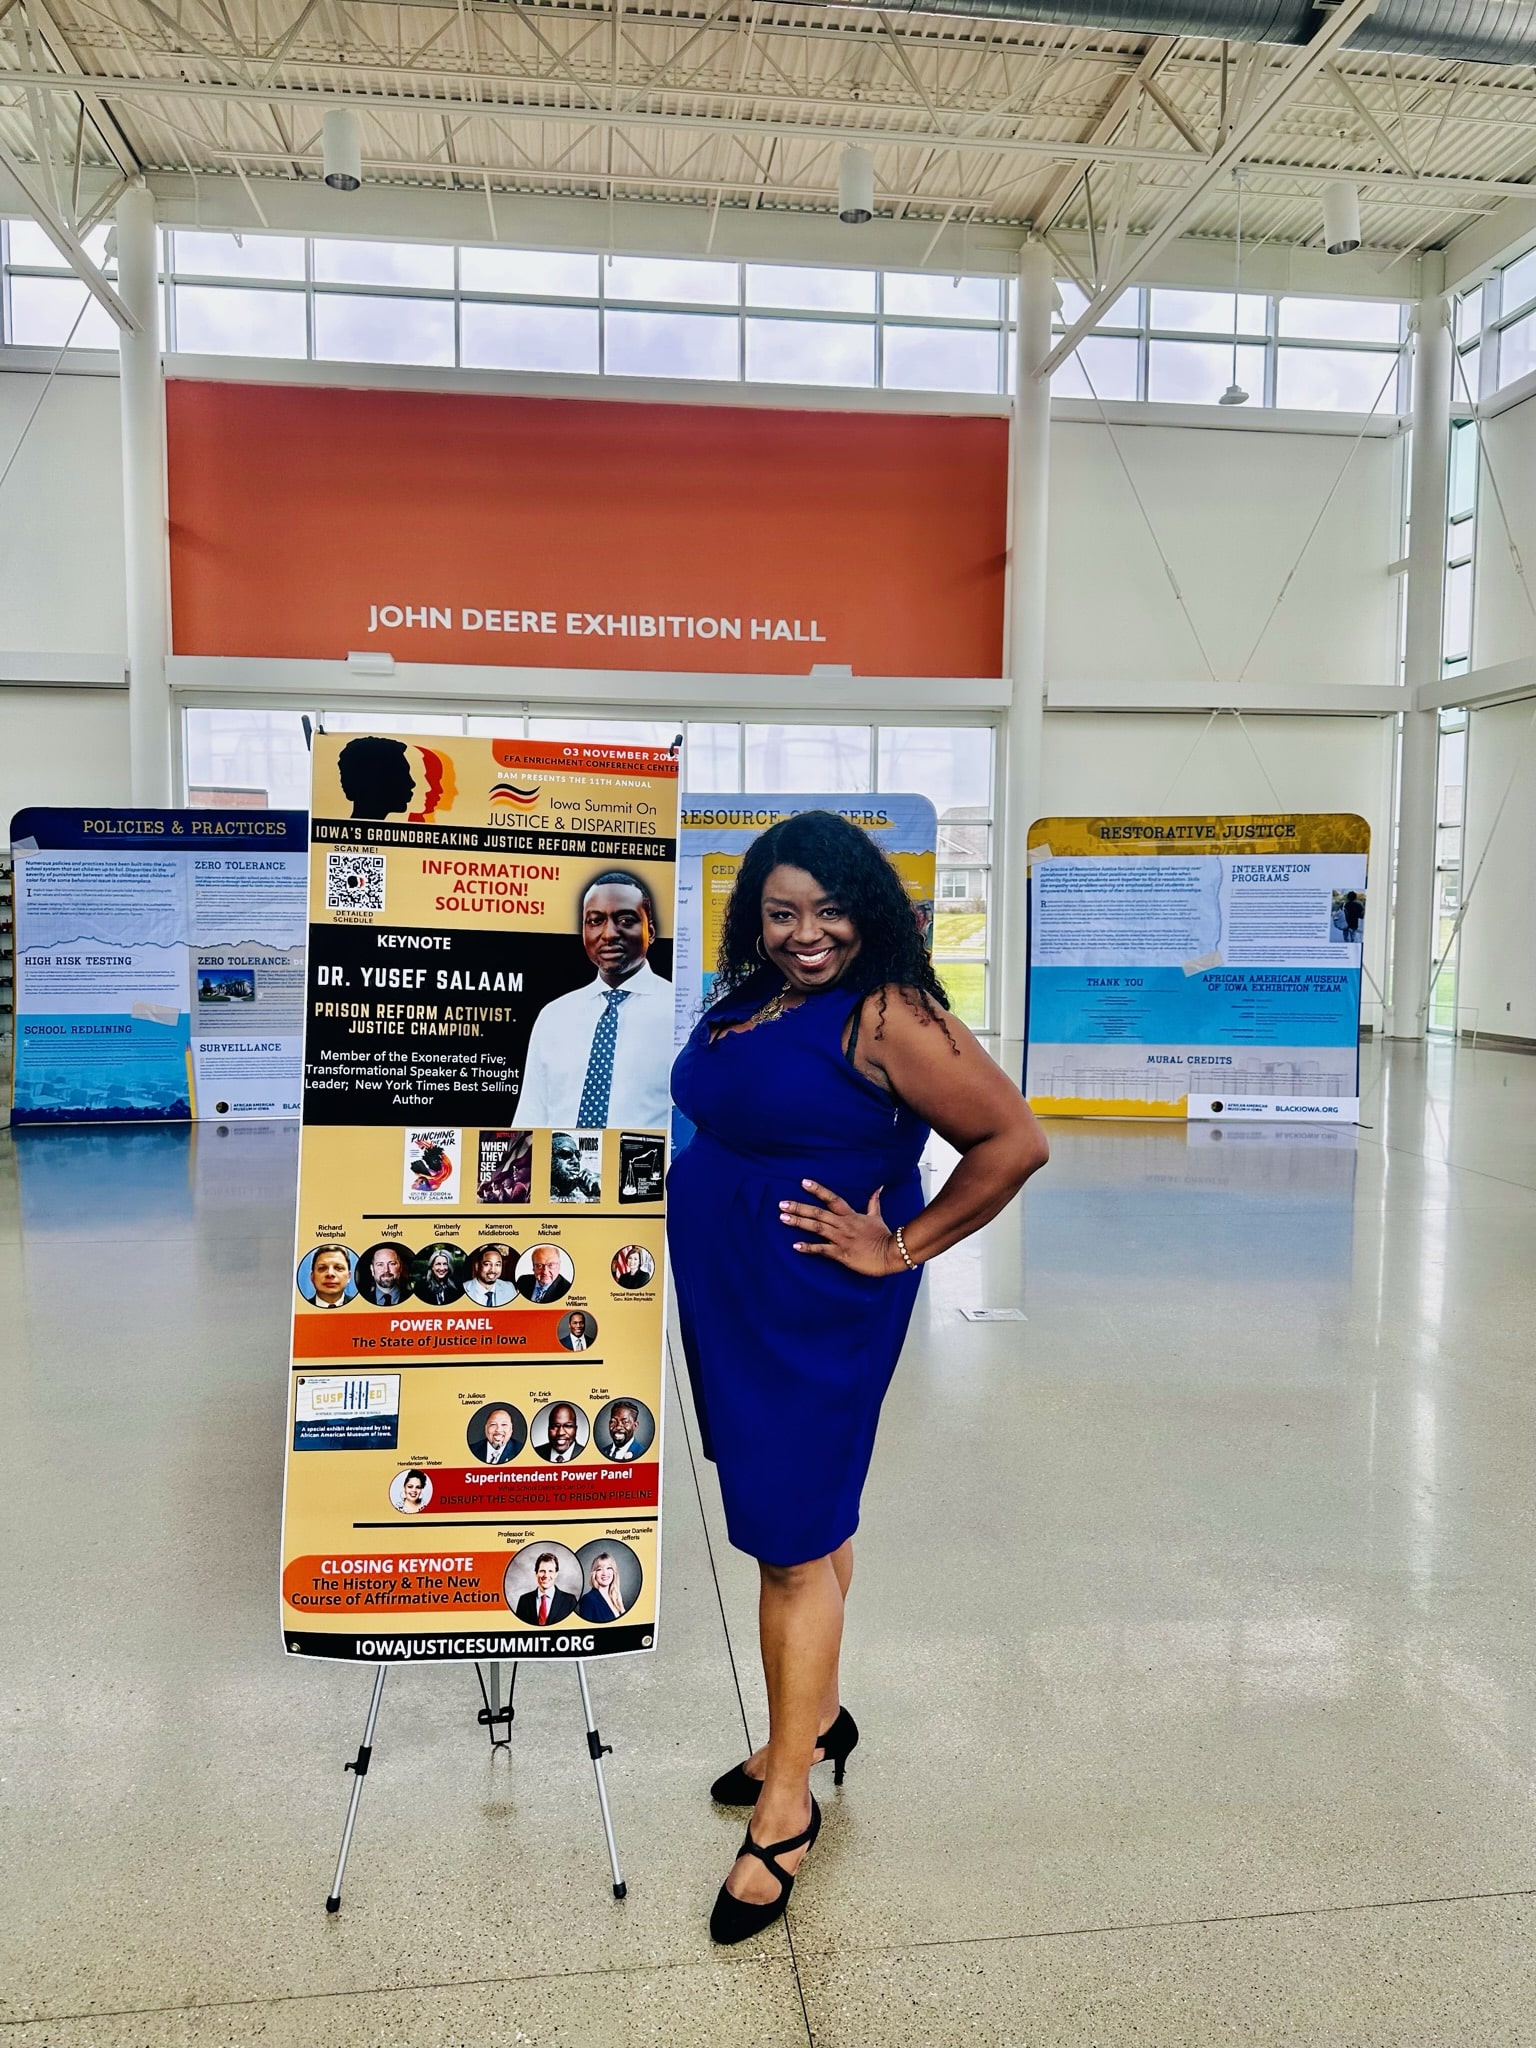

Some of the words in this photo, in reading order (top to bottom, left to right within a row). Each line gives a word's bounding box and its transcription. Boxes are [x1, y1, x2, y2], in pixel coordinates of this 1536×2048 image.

[368, 604, 452, 629] JOHN
[462, 608, 557, 634] DEERE
[566, 613, 741, 640] EXHIBITION
[750, 619, 826, 642] HALL
[583, 749, 649, 760] NOVEMBER
[504, 755, 521, 763] FFA
[523, 756, 583, 767] ENRICHMENT
[586, 760, 644, 770] CONFERENCE
[497, 772, 518, 780] BAM
[521, 773, 566, 783] PRESENTS
[569, 776, 586, 784] THE
[589, 777, 612, 786] 11TH
[615, 779, 652, 788] ANNUAL
[550, 797, 580, 811] Iowa
[585, 799, 632, 815] Summit
[636, 802, 657, 815] On
[487, 812, 549, 829] JUSTICE
[554, 816, 565, 830] &
[571, 817, 656, 835] DISPARITIES
[681, 810, 780, 825] RESOURCE
[83, 820, 164, 834] POLICIES
[171, 820, 184, 834] &
[191, 821, 287, 836] PRACTICES
[1100, 825, 1216, 840] RESTORATIVE
[1222, 824, 1296, 838] JUSTICE
[316, 825, 362, 840] IOWA'S
[367, 828, 479, 846] GROUNDBREAKING
[484, 835, 533, 850] JUSTICE
[538, 837, 586, 852] REFORM
[591, 840, 666, 857] CONFERENCE
[334, 845, 359, 853] SCAN
[362, 846, 378, 854] ME!
[195, 861, 222, 870] ZERO
[225, 861, 286, 870] TOLERANCE
[422, 859, 560, 881] INFORMATION!
[1232, 864, 1311, 873] INTERVENTION
[1231, 873, 1289, 882] PROGRAMS
[453, 879, 528, 897] ACTION!
[435, 896, 545, 915] SOLUTIONS!
[333, 916, 374, 924] SCHEDULE
[377, 934, 452, 950] KEYNOTE
[25, 957, 52, 966] HIGH
[56, 956, 82, 966] RISK
[86, 956, 132, 966] TESTING
[198, 957, 224, 966] ZERO
[228, 957, 291, 966] TOLERANCE:
[317, 965, 351, 987] DR.
[360, 967, 427, 988] YUSEF
[436, 970, 523, 992] SALAAM
[1086, 978, 1120, 987] THANK
[1124, 978, 1144, 987] YOU
[1202, 974, 1245, 983] AFRICAN
[1249, 974, 1301, 983] AMERICAN
[1305, 975, 1348, 984] MUSEUM
[1208, 983, 1221, 992] OF
[1224, 983, 1248, 992] IOWA
[1251, 983, 1309, 992] EXHIBITION
[1313, 984, 1342, 992] TEAM
[314, 1002, 370, 1018] PRISON
[376, 1004, 438, 1020] REFORM
[444, 1005, 517, 1023] ACTIVIST.
[24, 1025, 67, 1035] SCHOOL
[71, 1025, 133, 1034] REDLINING
[348, 1020, 405, 1035] JUSTICE
[410, 1022, 484, 1037] CHAMPION.
[200, 1043, 282, 1052] SURVEILLANCE
[320, 1050, 372, 1062] Member
[373, 1051, 387, 1062] of
[388, 1051, 408, 1062] the
[411, 1052, 478, 1064] Exonerated
[480, 1053, 507, 1066] Five;
[1146, 1055, 1183, 1064] MURAL
[1187, 1056, 1233, 1065] CREDITS
[305, 1064, 407, 1077] Transformational
[409, 1066, 457, 1080] Speaker
[459, 1067, 468, 1078] &
[471, 1067, 520, 1081] Thought
[304, 1078, 349, 1091] Leader;
[355, 1079, 382, 1091] New
[385, 1080, 413, 1091] York
[416, 1080, 450, 1091] Times
[453, 1081, 479, 1091] Best
[481, 1081, 519, 1095] Selling
[392, 1094, 434, 1106] Author
[1275, 1105, 1339, 1113] BLACKIOWA.ORG
[411, 1129, 455, 1143] PUNCHING
[440, 1138, 456, 1146] AIR
[481, 1141, 508, 1152] WHEN
[578, 1137, 599, 1151] WORDS
[480, 1151, 504, 1162] THEY
[480, 1161, 497, 1172] SEE
[480, 1171, 492, 1182] US
[315, 1230, 346, 1238] Westphal
[381, 1230, 403, 1238] Wright
[433, 1223, 461, 1231] Kimberly
[478, 1229, 519, 1237] Middlebrooks
[537, 1229, 561, 1237] Michael
[390, 1319, 443, 1332] POWER
[446, 1318, 493, 1331] PANEL
[352, 1336, 377, 1348] The
[379, 1336, 415, 1348] State
[417, 1335, 432, 1347] of
[433, 1335, 477, 1349] Justice
[480, 1334, 493, 1345] in
[496, 1334, 527, 1345] Iowa
[464, 1470, 559, 1486] Superintendent
[561, 1469, 598, 1482] Power
[600, 1468, 633, 1480] Panel
[440, 1494, 485, 1505] DISRUPT
[487, 1494, 508, 1504] THE
[509, 1492, 550, 1503] SCHOOL
[553, 1492, 567, 1502] TO
[569, 1491, 606, 1501] PRISON
[609, 1489, 653, 1500] PIPELINE
[320, 1558, 394, 1575] CLOSING
[398, 1556, 474, 1574] KEYNOTE
[312, 1577, 339, 1591] The
[342, 1576, 396, 1593] History
[400, 1576, 412, 1589] &
[416, 1575, 443, 1589] The
[447, 1574, 480, 1588] New
[291, 1592, 343, 1606] Course
[345, 1591, 362, 1606] of
[363, 1589, 450, 1605] Affirmative
[452, 1589, 501, 1604] Action
[355, 1635, 595, 1658] IOWAJUSTICESUMMIT.ORG
